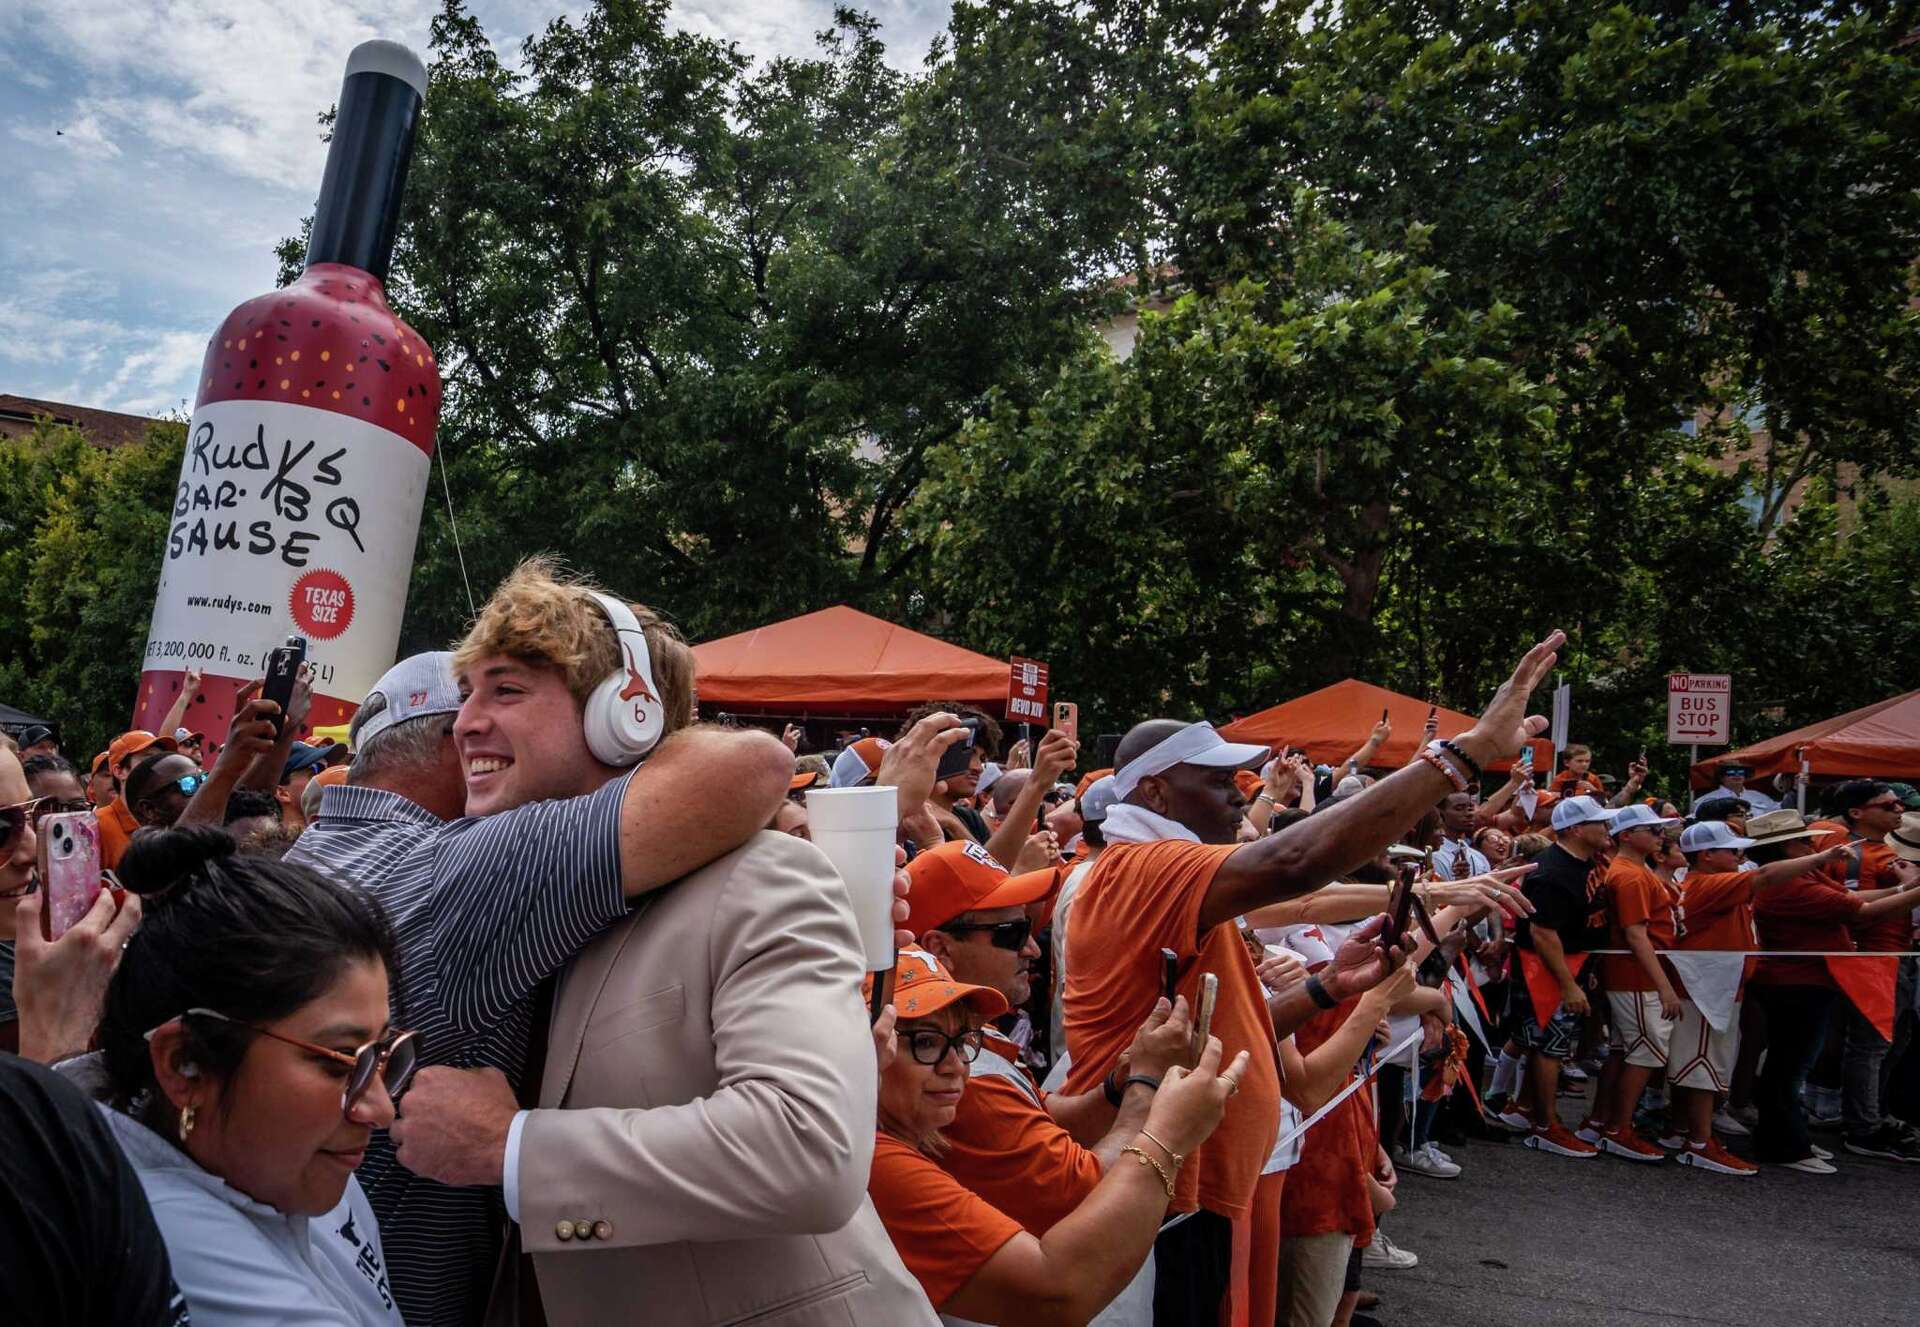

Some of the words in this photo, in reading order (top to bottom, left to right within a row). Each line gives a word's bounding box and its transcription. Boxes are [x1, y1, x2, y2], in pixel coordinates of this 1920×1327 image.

[170, 518, 320, 567] SAUSE
[187, 594, 272, 615] www.rudys.com
[304, 587, 346, 607] TEXAS
[311, 605, 338, 623] SIZE
[219, 645, 231, 662] fl.
[237, 653, 255, 666] oz.
[1671, 676, 1688, 690] NO
[1689, 679, 1727, 690] PARKING
[409, 691, 428, 707] 27
[1681, 697, 1716, 711] BUS
[1677, 712, 1720, 727] STOP
